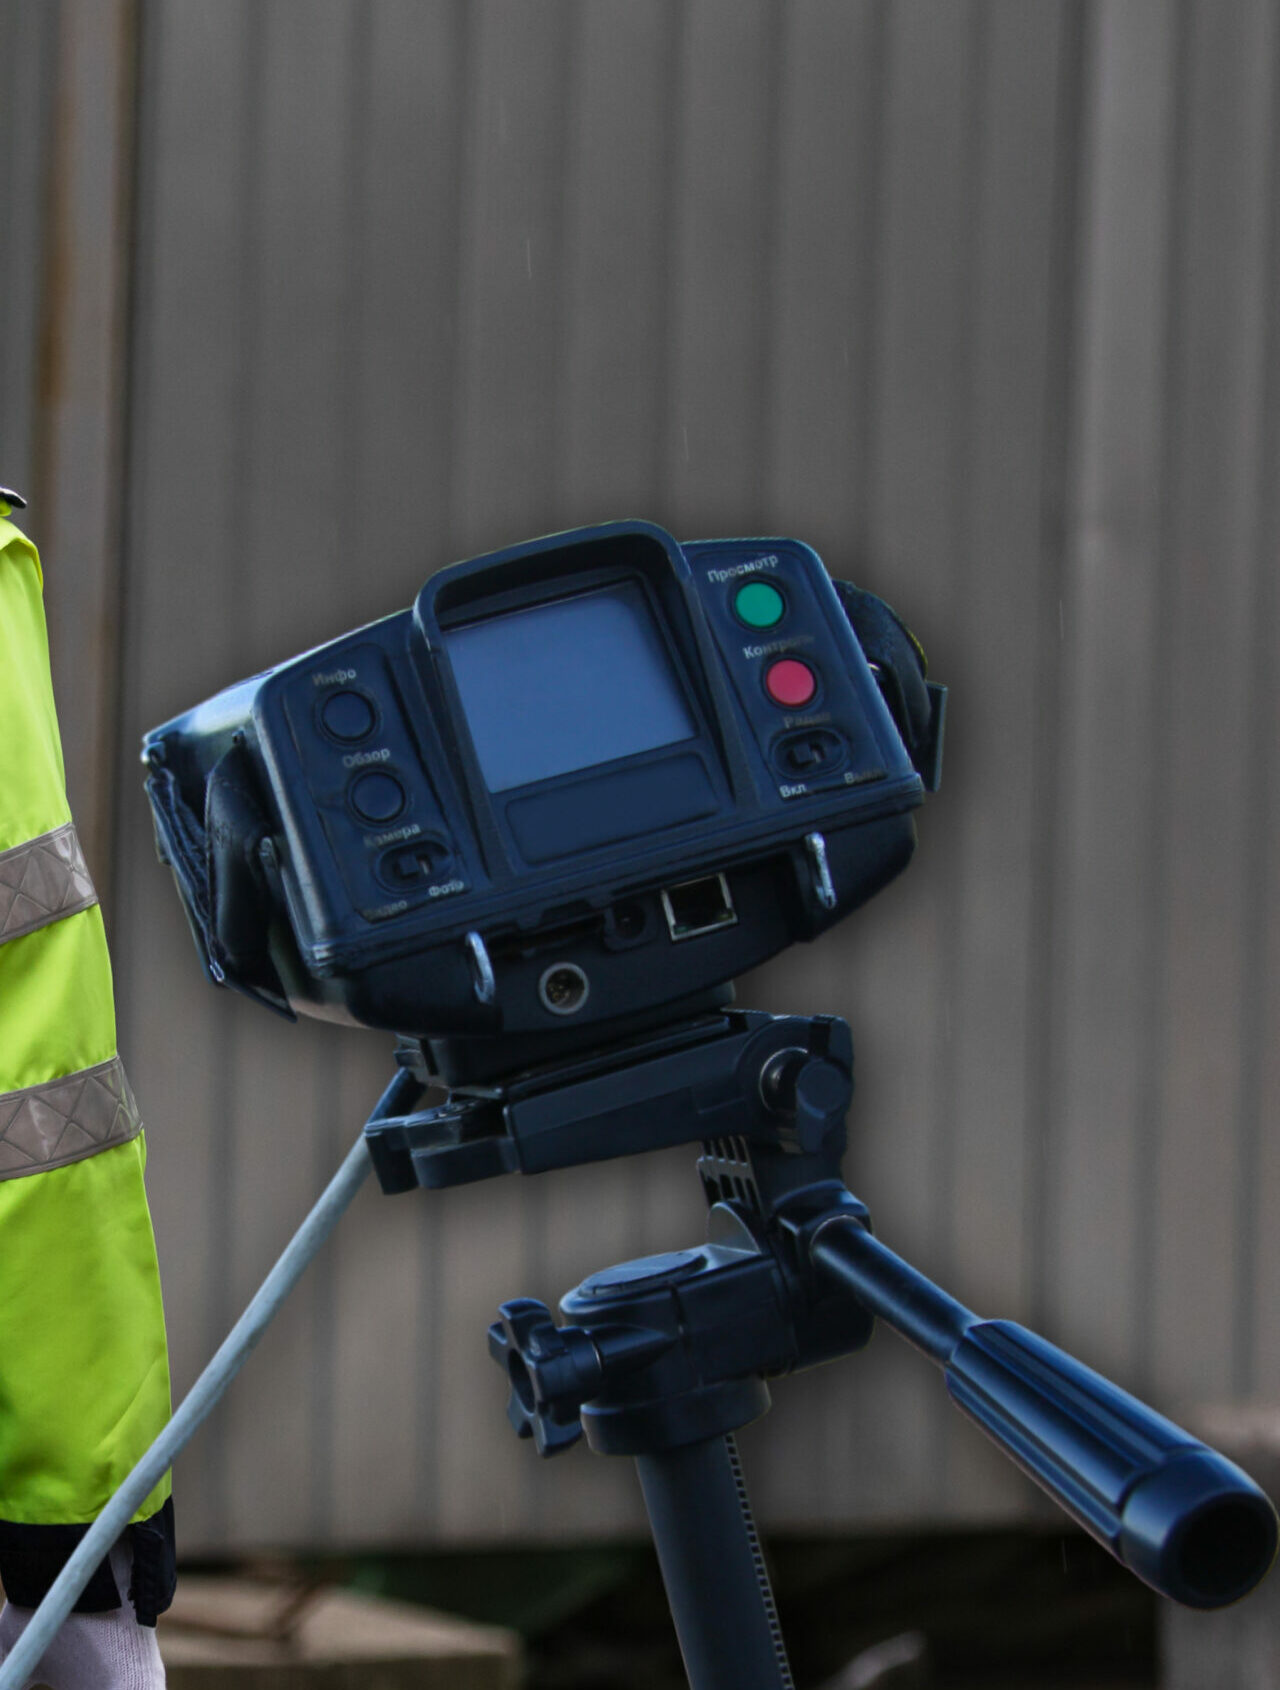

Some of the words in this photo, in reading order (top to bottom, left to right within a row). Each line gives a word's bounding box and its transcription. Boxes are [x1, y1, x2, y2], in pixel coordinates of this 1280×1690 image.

[707, 555, 778, 583] Просмотр
[312, 668, 357, 686] Инфо
[342, 748, 390, 769] Обзор
[779, 782, 807, 798] Вкл
